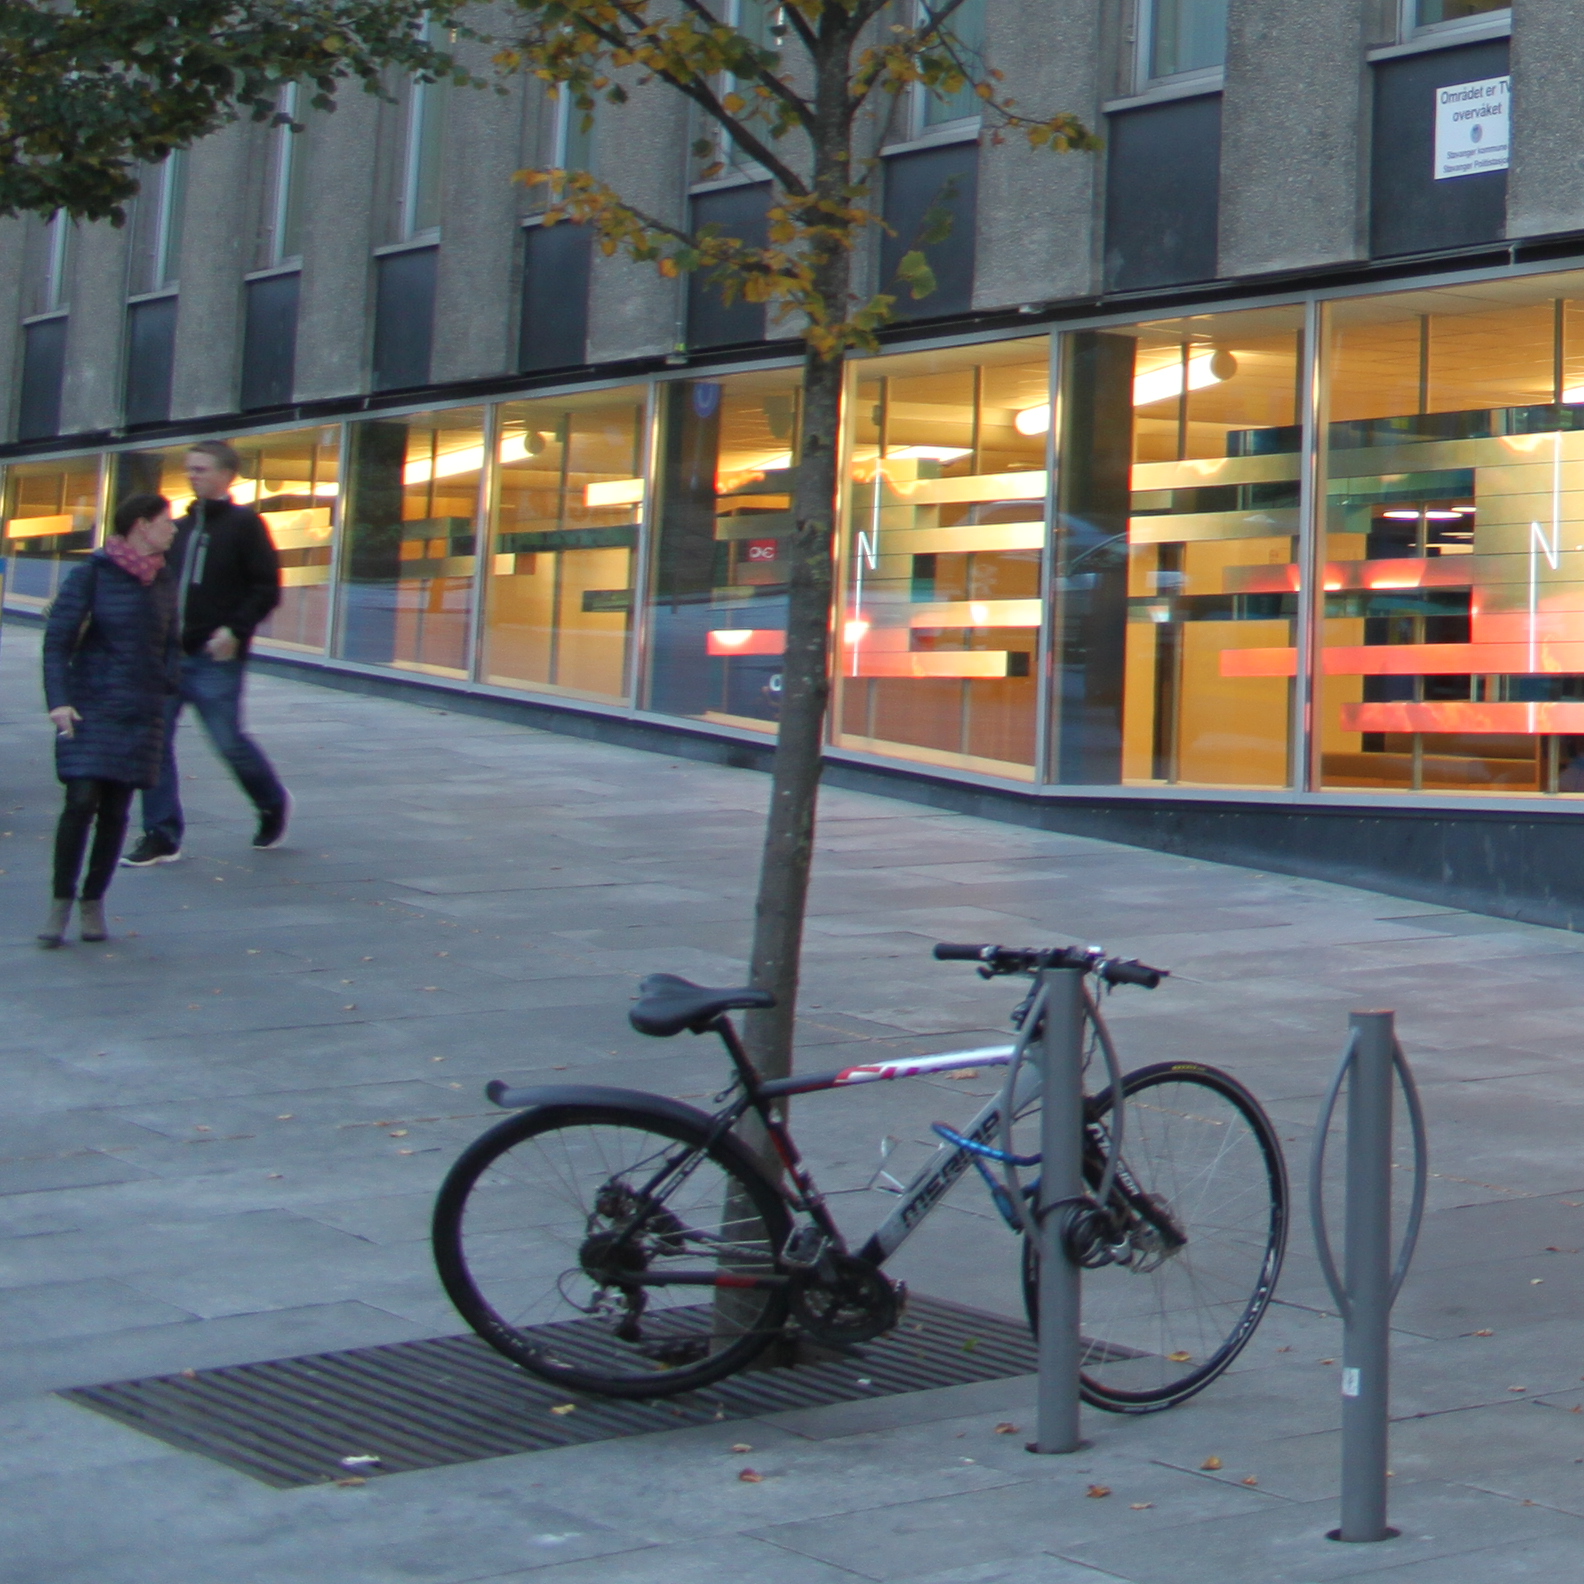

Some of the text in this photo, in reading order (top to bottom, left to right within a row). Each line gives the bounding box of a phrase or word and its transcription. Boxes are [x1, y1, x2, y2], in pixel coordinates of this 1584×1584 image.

[1440, 86, 1484, 104] Området
[1486, 84, 1497, 97] er
[1452, 103, 1503, 122] overvåket
